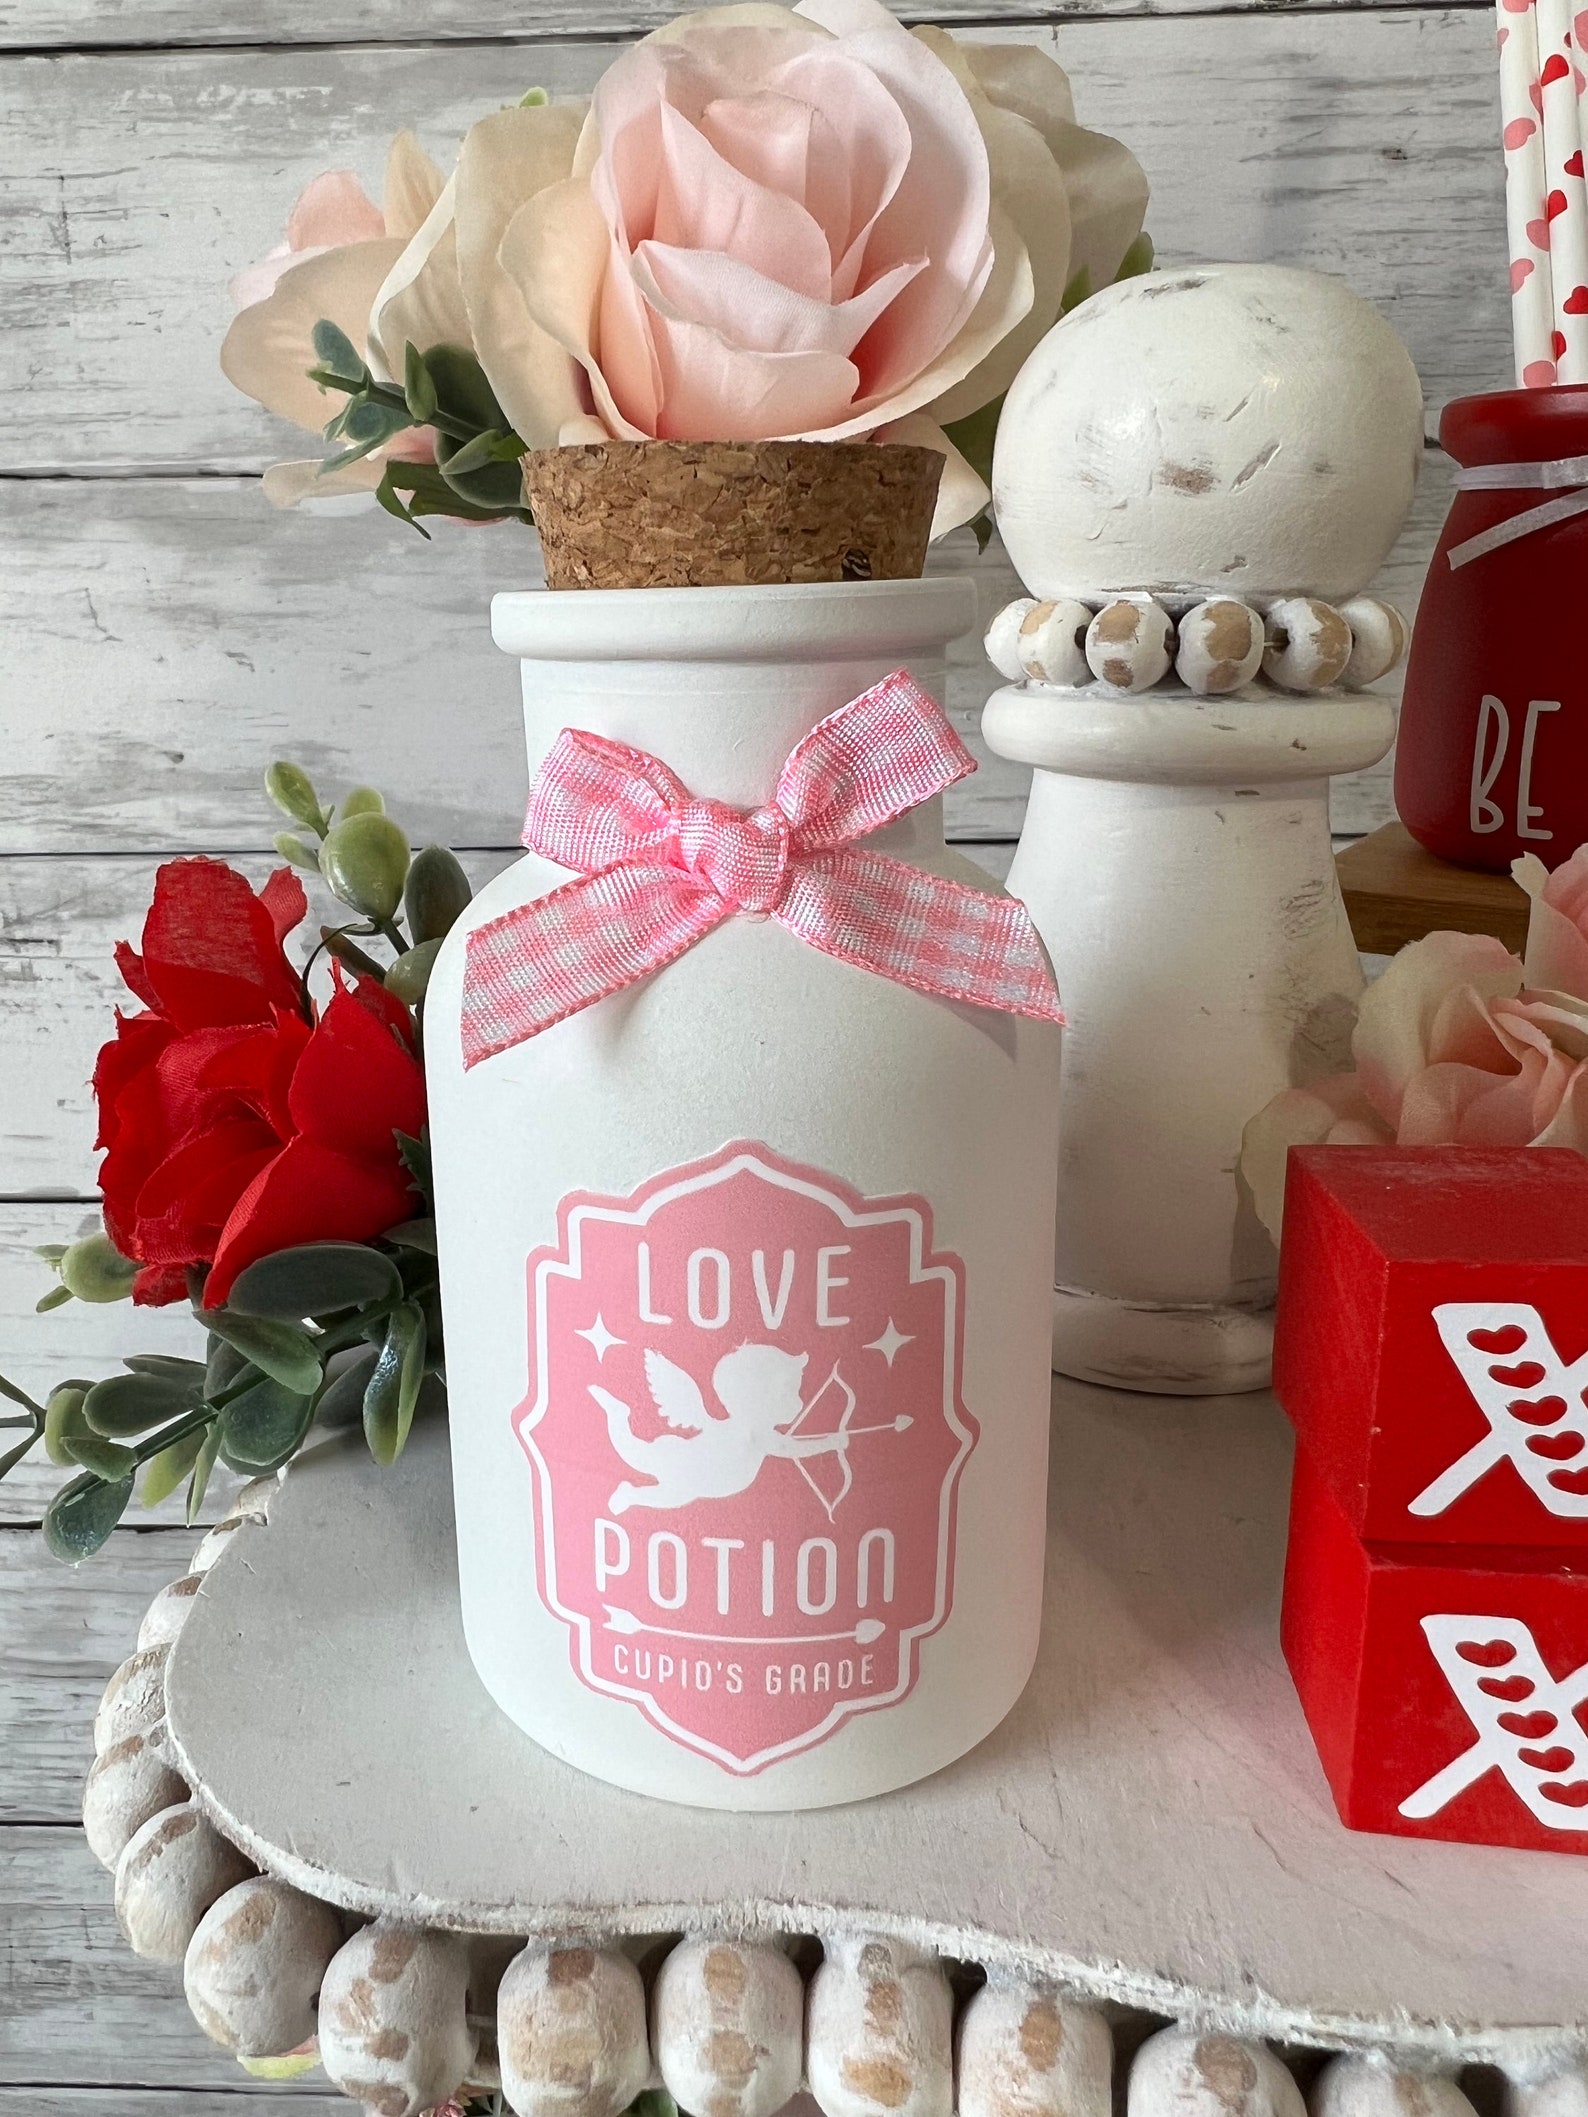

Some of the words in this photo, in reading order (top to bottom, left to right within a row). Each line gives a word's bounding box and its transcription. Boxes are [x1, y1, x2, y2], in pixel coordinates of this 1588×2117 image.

[1470, 694, 1561, 840] BE
[637, 1242, 852, 1330] LOVE
[593, 1517, 895, 1616] POTION
[613, 1643, 744, 1692] CUPID'S
[765, 1654, 875, 1695] GRADE
